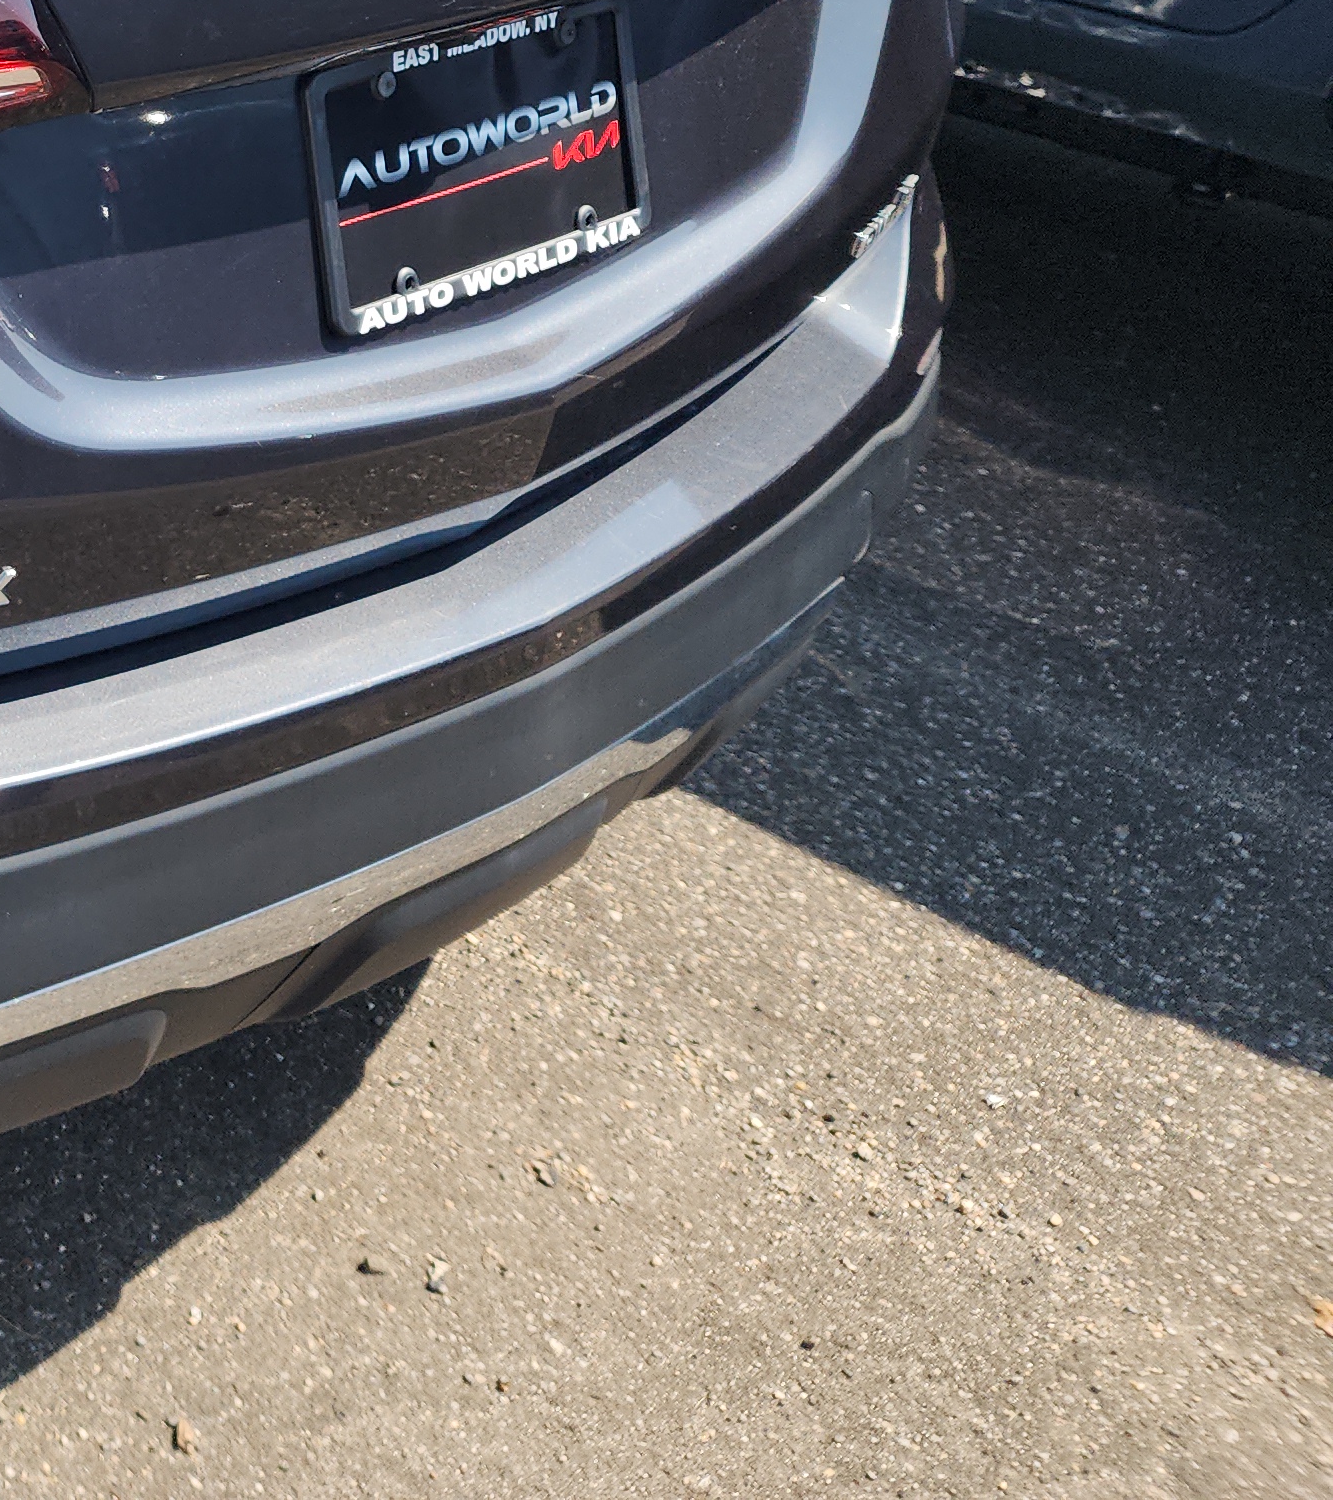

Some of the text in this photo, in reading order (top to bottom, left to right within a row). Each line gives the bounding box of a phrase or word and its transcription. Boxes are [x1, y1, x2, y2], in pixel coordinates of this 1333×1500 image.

[534, 11, 559, 33] NY
[338, 79, 617, 199] AUTOWORLD
[552, 120, 621, 171] KIA
[359, 215, 642, 334] AUTO WORLD KIA
